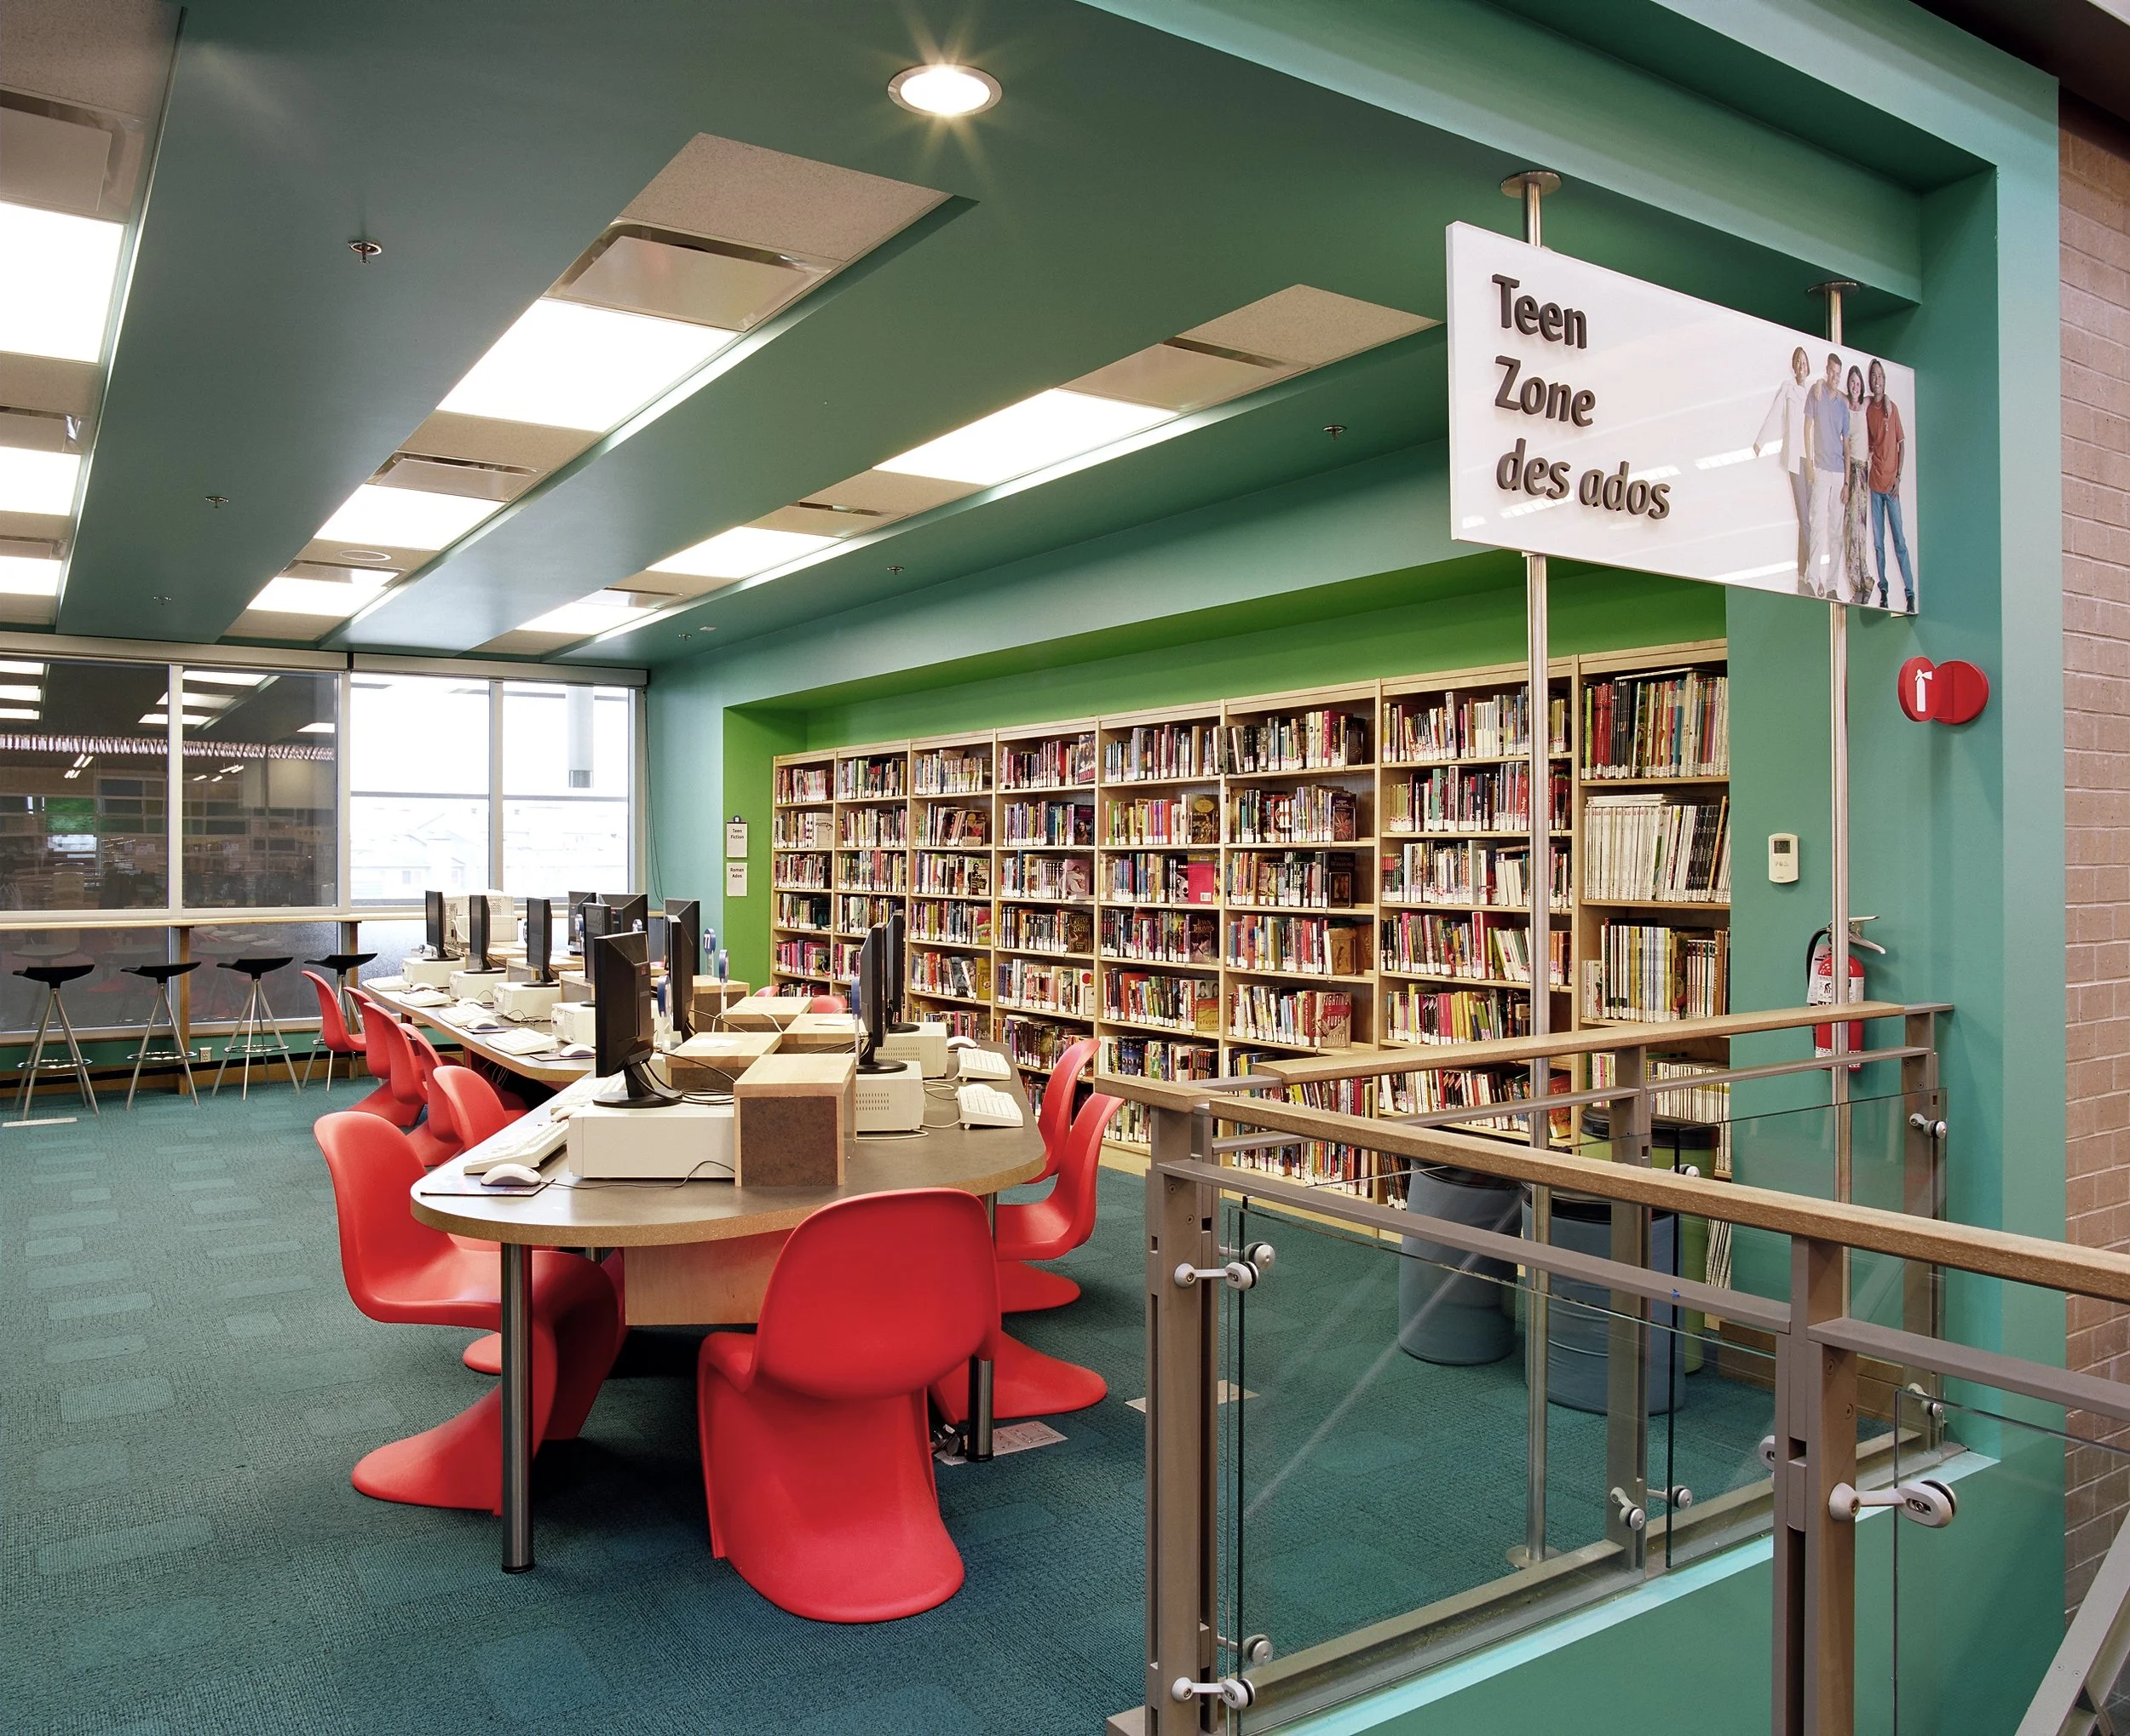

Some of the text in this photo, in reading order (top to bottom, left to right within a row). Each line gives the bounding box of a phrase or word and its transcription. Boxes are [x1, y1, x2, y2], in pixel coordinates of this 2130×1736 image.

[1492, 273, 1587, 349] Teen
[1494, 355, 1597, 427] Zone
[1496, 438, 1671, 520] des ados
